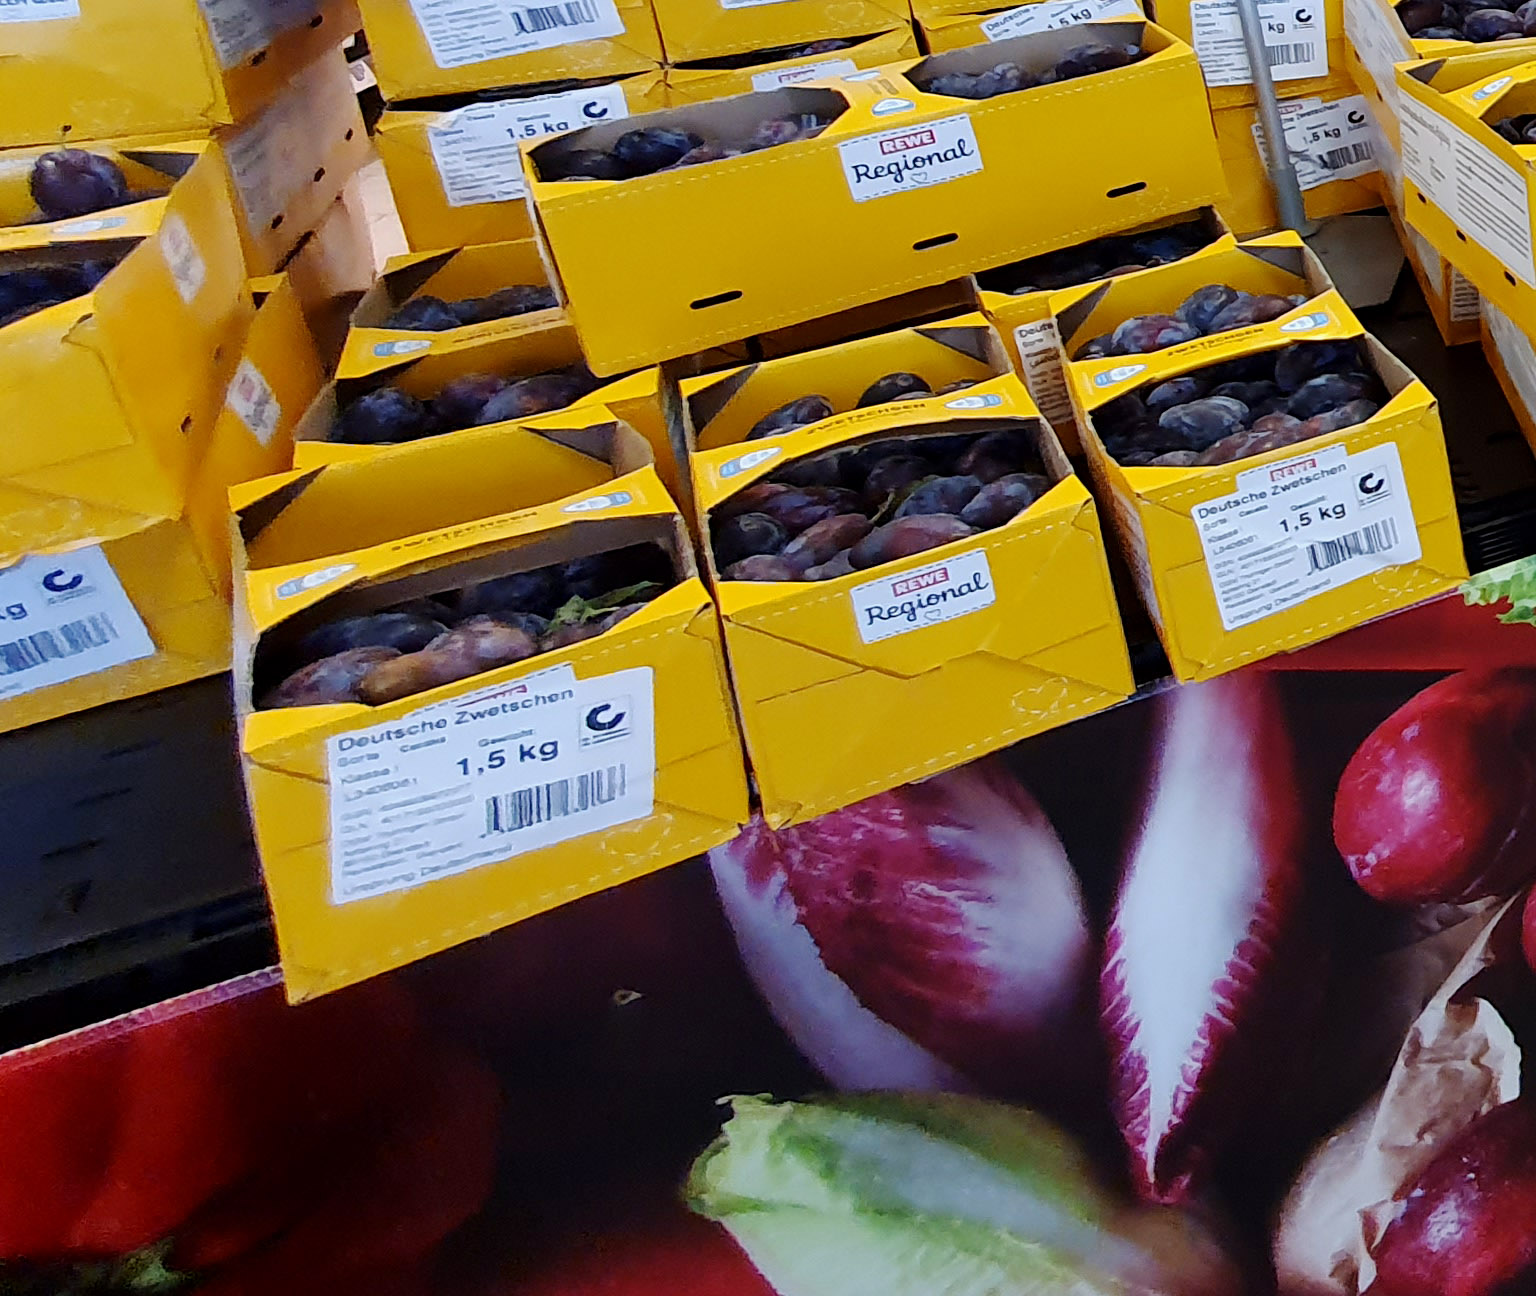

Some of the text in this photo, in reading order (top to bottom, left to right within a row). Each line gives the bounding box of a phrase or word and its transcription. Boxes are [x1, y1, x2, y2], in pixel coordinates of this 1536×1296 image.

[1070, 7, 1092, 24] kg
[1268, 22, 1285, 33] kg
[881, 131, 934, 154] REWE
[1324, 126, 1340, 138] kg
[851, 138, 974, 184] Regional
[1198, 463, 1347, 519] Deutsche Zwetschen
[1280, 503, 1346, 532] 1,5 kg
[893, 568, 948, 596] REWE
[865, 571, 991, 627] Regional
[338, 717, 448, 752] Deutsche
[455, 687, 574, 725] Zwetschen
[456, 738, 560, 776] 1,5 kg
